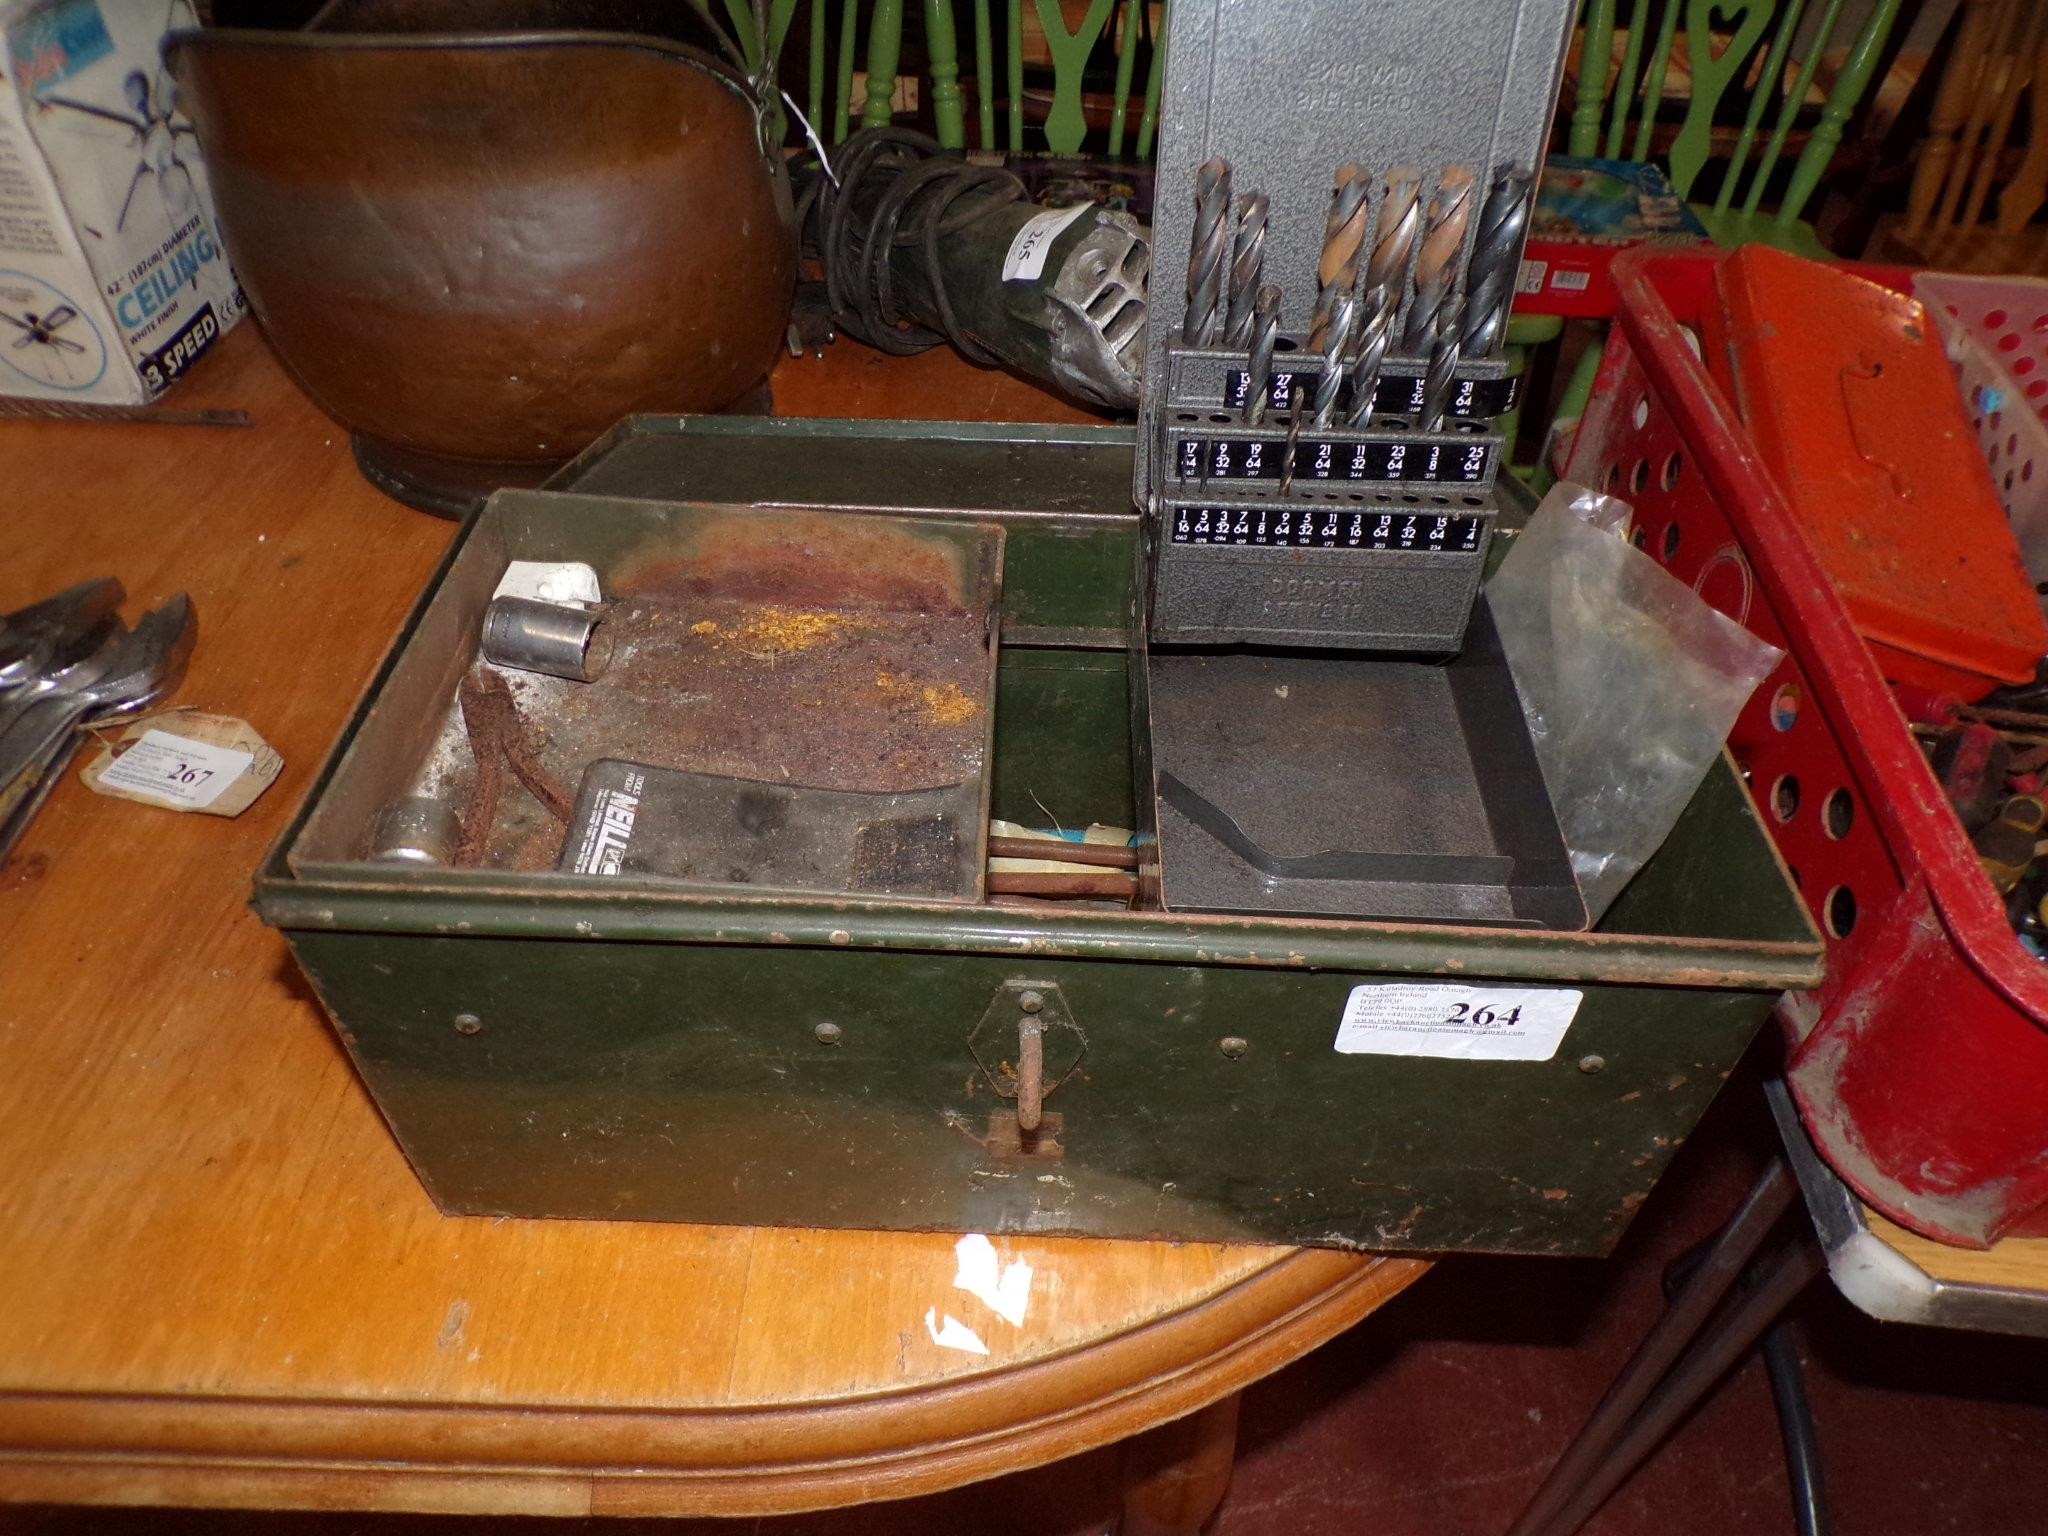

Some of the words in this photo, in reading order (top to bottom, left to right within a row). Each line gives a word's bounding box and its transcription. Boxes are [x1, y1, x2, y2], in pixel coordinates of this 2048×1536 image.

[162, 214, 201, 254] DIAMETER
[1018, 230, 1044, 260] 265
[117, 230, 214, 329] CEILING
[130, 322, 155, 346] WHITE
[158, 301, 179, 324] FINISH
[145, 365, 164, 388] 3
[164, 314, 217, 376] SPEED
[1277, 375, 1292, 385] 27
[1461, 382, 1473, 393] 31
[1274, 389, 1288, 399] 64
[1456, 396, 1471, 406] 64
[1186, 443, 1198, 454] 17
[1220, 444, 1228, 454] 9
[1251, 444, 1262, 455] 19
[1319, 445, 1331, 456] 21
[1357, 445, 1366, 456] 11
[1391, 446, 1406, 457] 23
[1432, 447, 1440, 457] 3
[1468, 447, 1484, 458] 25
[1216, 457, 1230, 468] 32
[1246, 458, 1261, 468] 64
[1315, 459, 1331, 469] 64
[1352, 459, 1366, 469] 32
[1387, 460, 1403, 470] 64
[1429, 460, 1437, 471] 8
[1464, 461, 1480, 471] 64
[1182, 510, 1187, 519] 1
[1200, 510, 1208, 520] 5
[1220, 511, 1228, 521] 3
[1240, 512, 1248, 521] 7
[1262, 512, 1266, 522] 1
[1282, 513, 1290, 522] 9
[1304, 513, 1311, 523] 5
[1329, 514, 1338, 523] 11
[1354, 515, 1361, 525] 3
[1380, 516, 1391, 526] 13
[1407, 517, 1416, 527] 7
[1437, 517, 1447, 527] 15
[1472, 519, 1477, 528] 1
[1179, 523, 1189, 532] 16
[1195, 524, 1209, 533] 64
[1215, 524, 1229, 533] 32
[1234, 524, 1248, 534] 64
[1258, 525, 1265, 534] 8
[1274, 525, 1289, 534] 64
[1298, 526, 1313, 535] 32
[1322, 526, 1337, 536] 64
[1350, 527, 1362, 537] 16
[1373, 527, 1389, 538] 64
[1401, 529, 1416, 539] 32
[1429, 530, 1444, 540] 64
[1467, 530, 1475, 540] 4
[167, 764, 215, 787] 267
[633, 775, 645, 796] TOOLS
[589, 791, 639, 868] NEILL
[1444, 1002, 1522, 1025] 264
